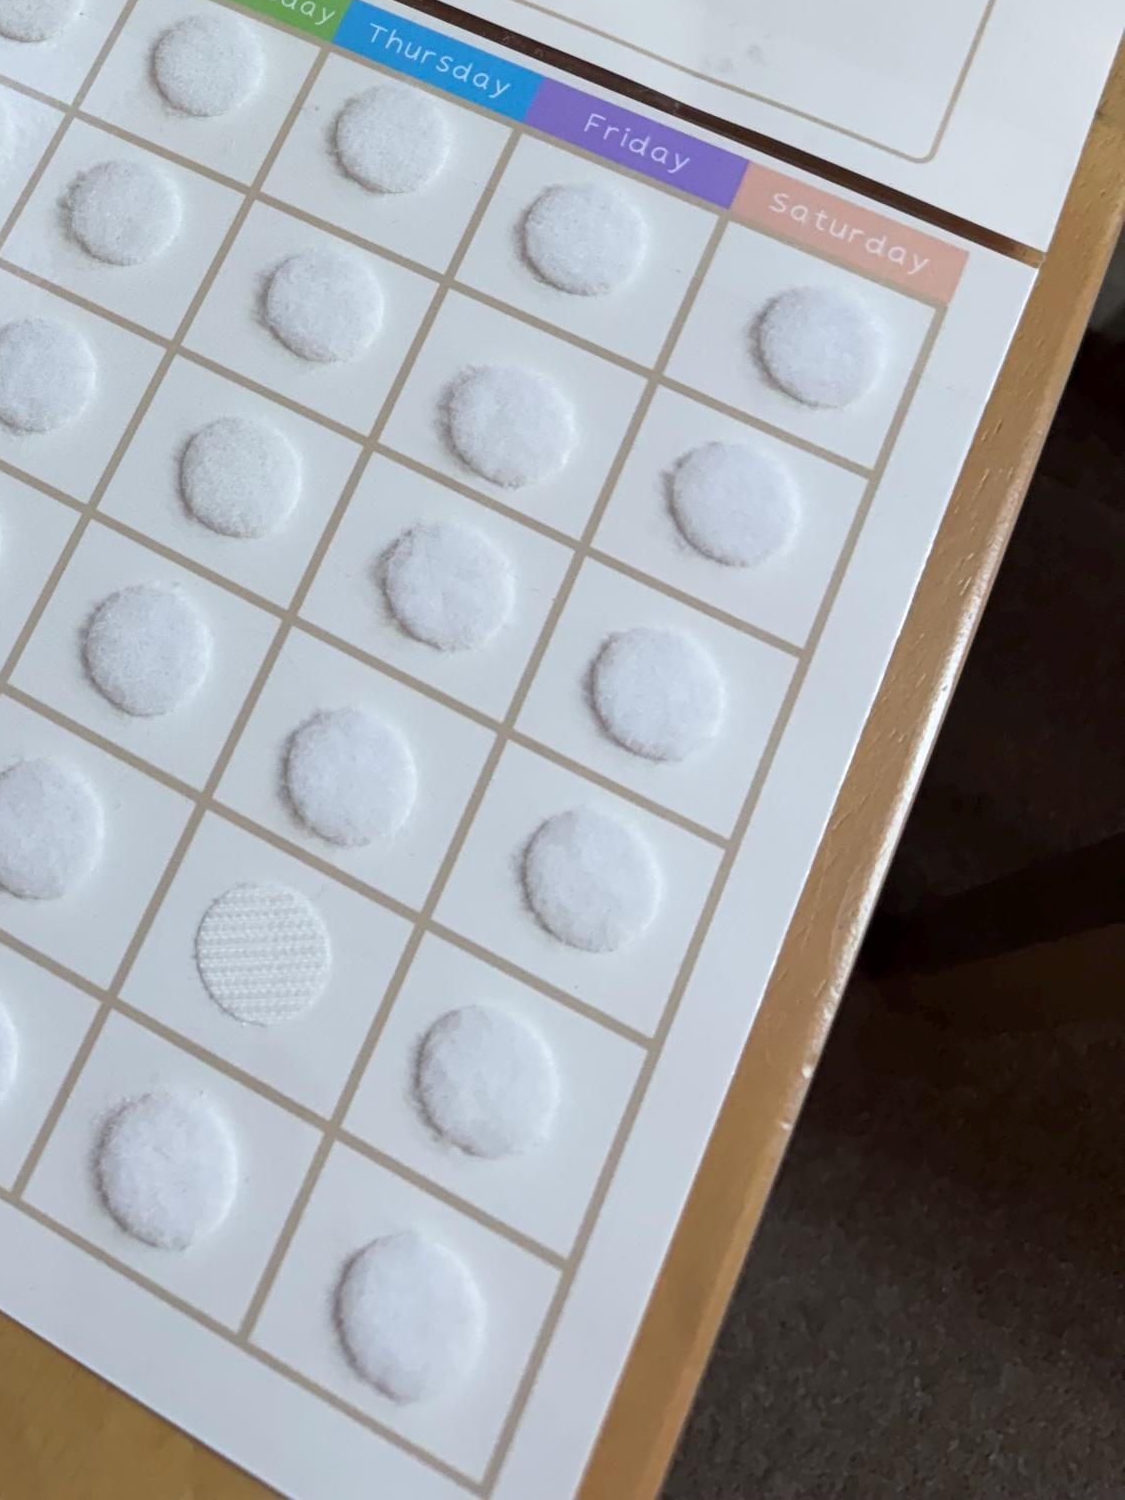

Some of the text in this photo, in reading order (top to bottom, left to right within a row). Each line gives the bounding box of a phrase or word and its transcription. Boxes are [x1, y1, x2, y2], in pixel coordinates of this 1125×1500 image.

[369, 22, 513, 100] Thursday
[582, 112, 691, 175] Friday
[768, 192, 930, 276] Saturday
